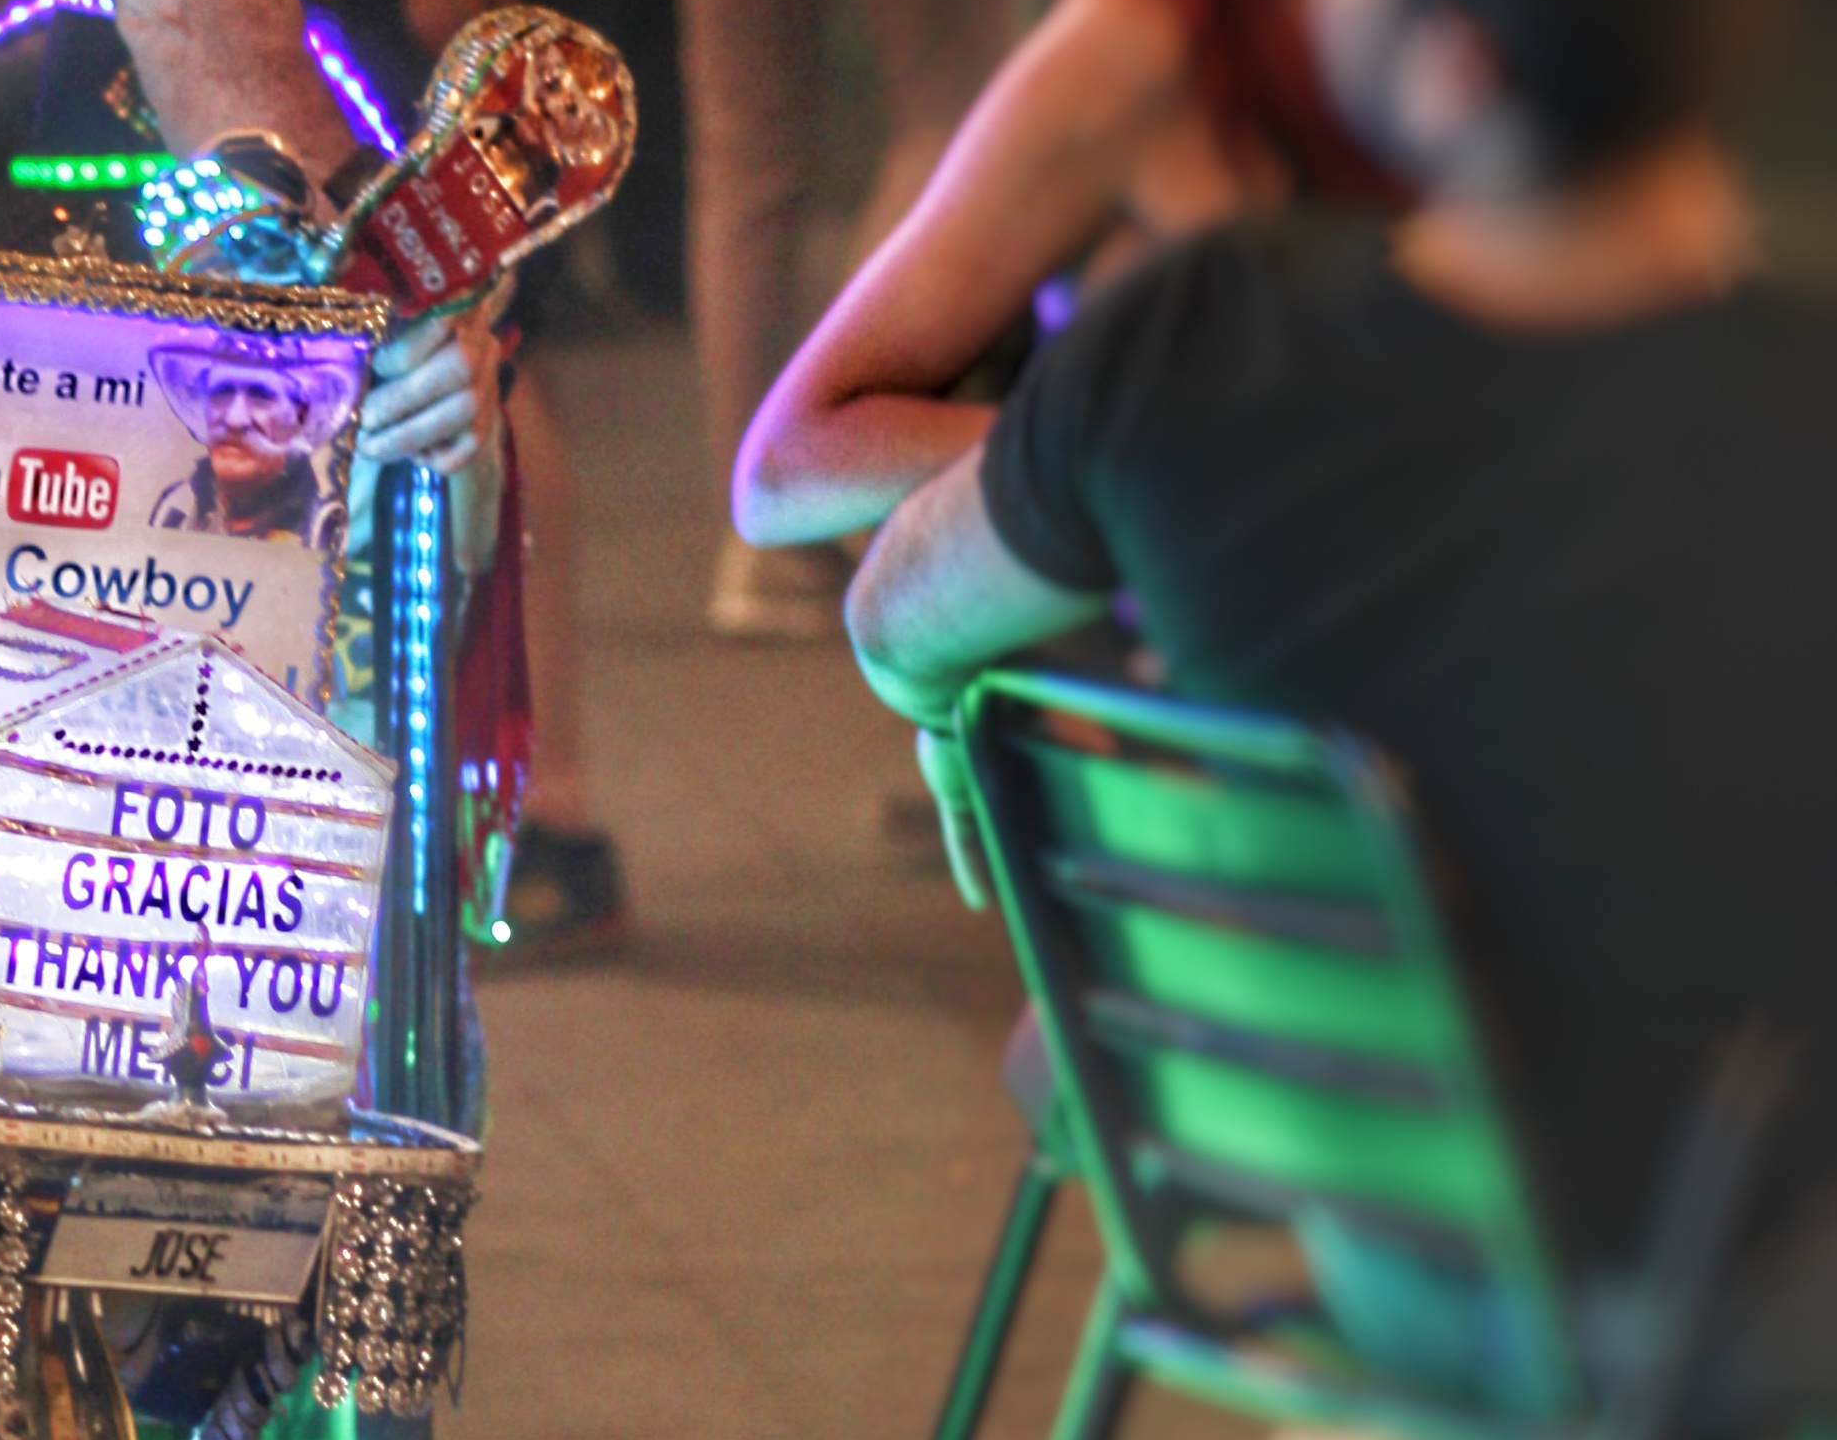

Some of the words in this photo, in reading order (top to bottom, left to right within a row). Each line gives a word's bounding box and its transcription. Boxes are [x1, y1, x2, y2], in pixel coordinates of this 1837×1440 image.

[54, 371, 78, 400] a
[93, 371, 147, 407] mi
[6, 542, 254, 627] Cowboy
[112, 781, 266, 851] FOTO
[62, 852, 304, 932] GRACIAS
[0, 927, 192, 999] THANK
[225, 949, 345, 1017] YOU
[81, 1015, 256, 1090] MECI
[129, 1228, 232, 1283] JOSE
